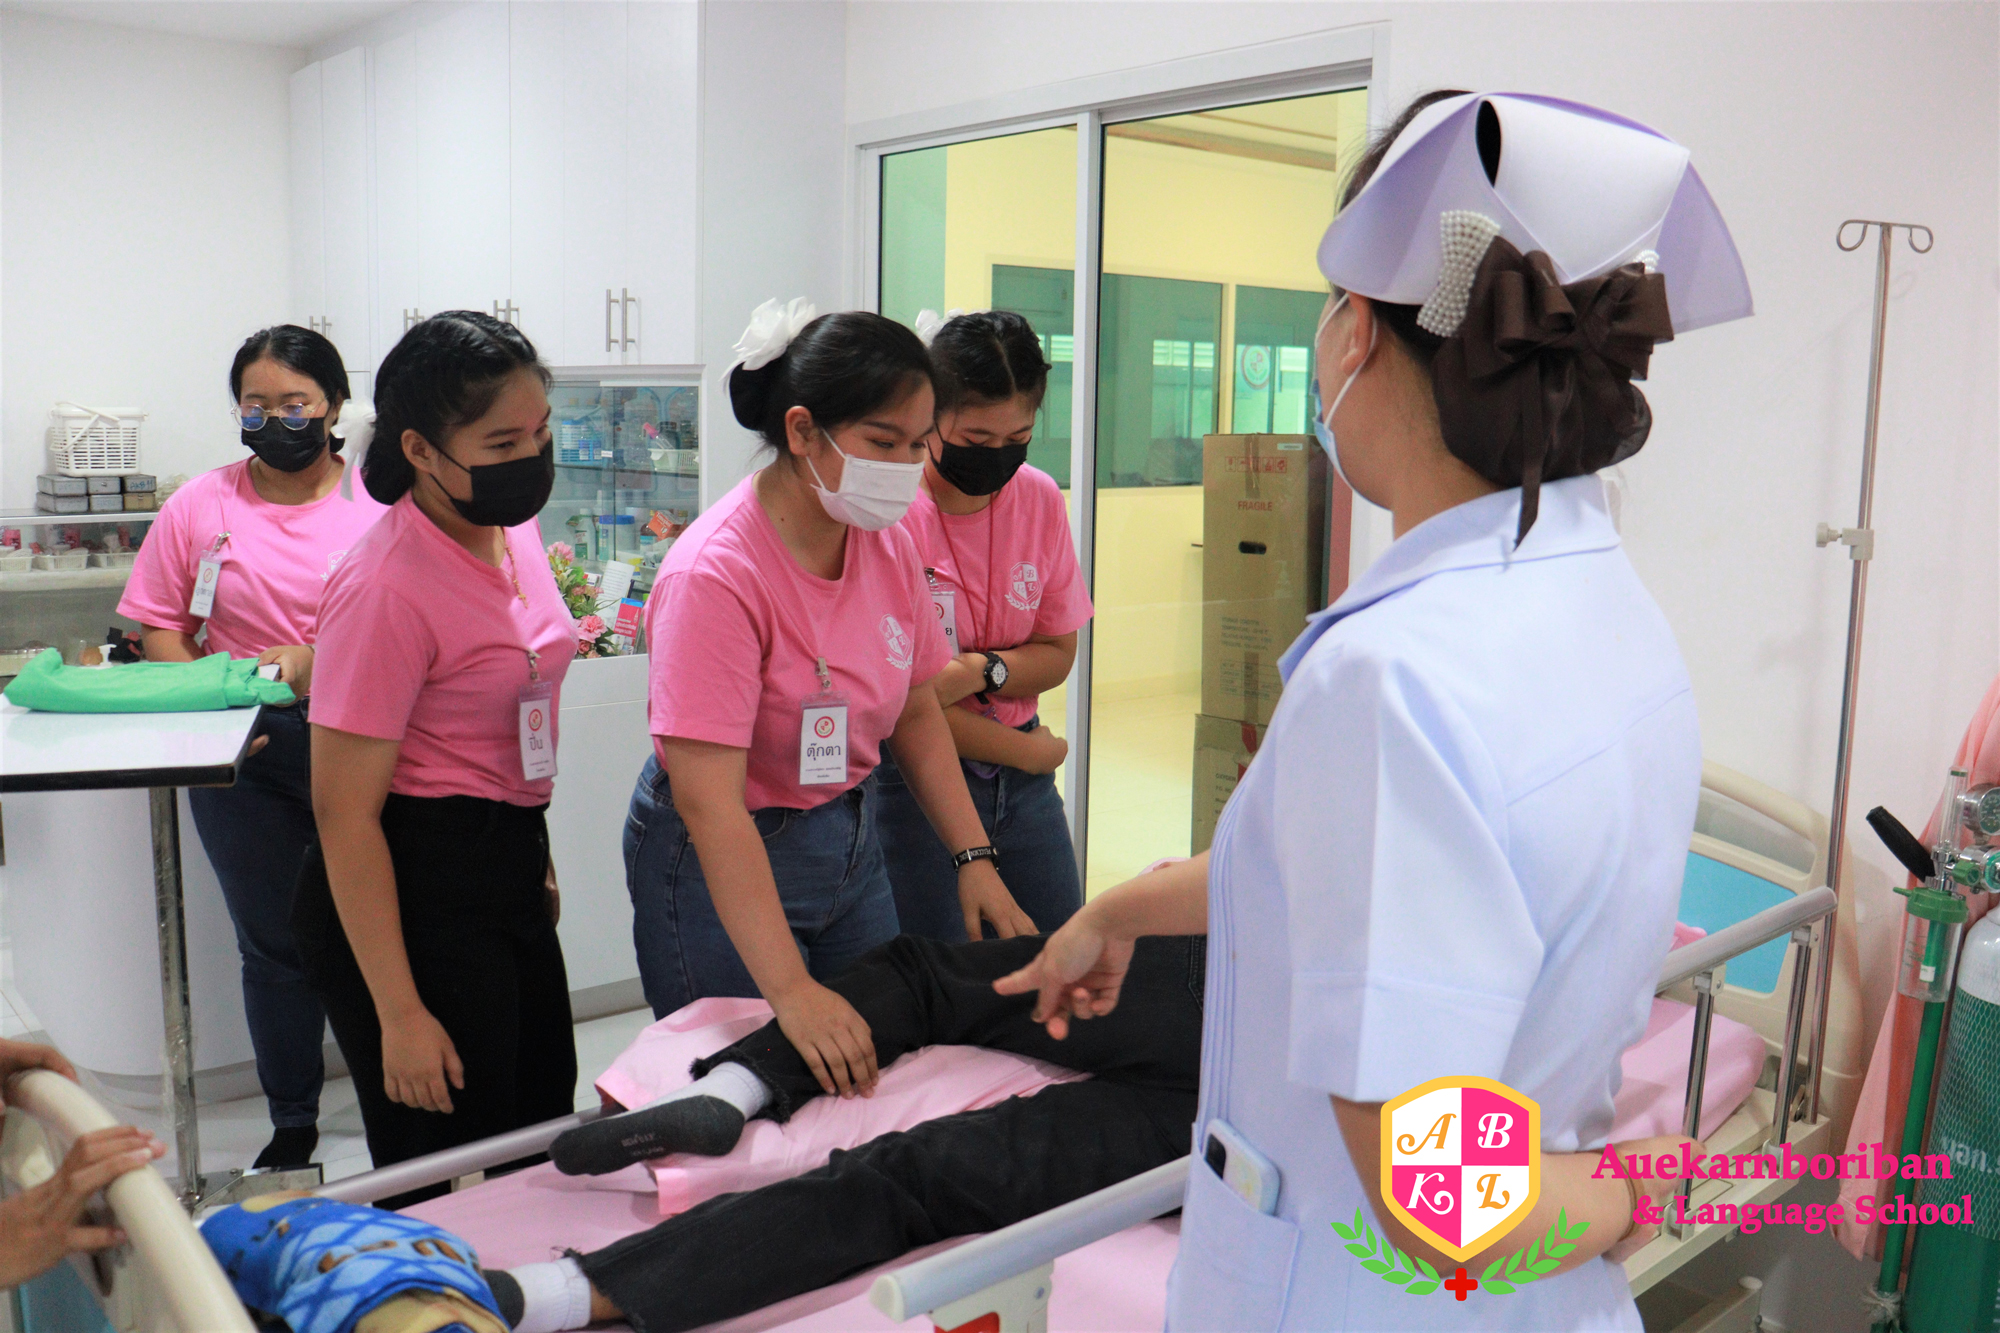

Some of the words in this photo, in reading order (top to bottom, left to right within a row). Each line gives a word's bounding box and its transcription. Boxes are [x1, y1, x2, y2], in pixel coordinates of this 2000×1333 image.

[1238, 501, 1272, 511] FRAGILE
[806, 742, 842, 761] ตุ๊กตา
